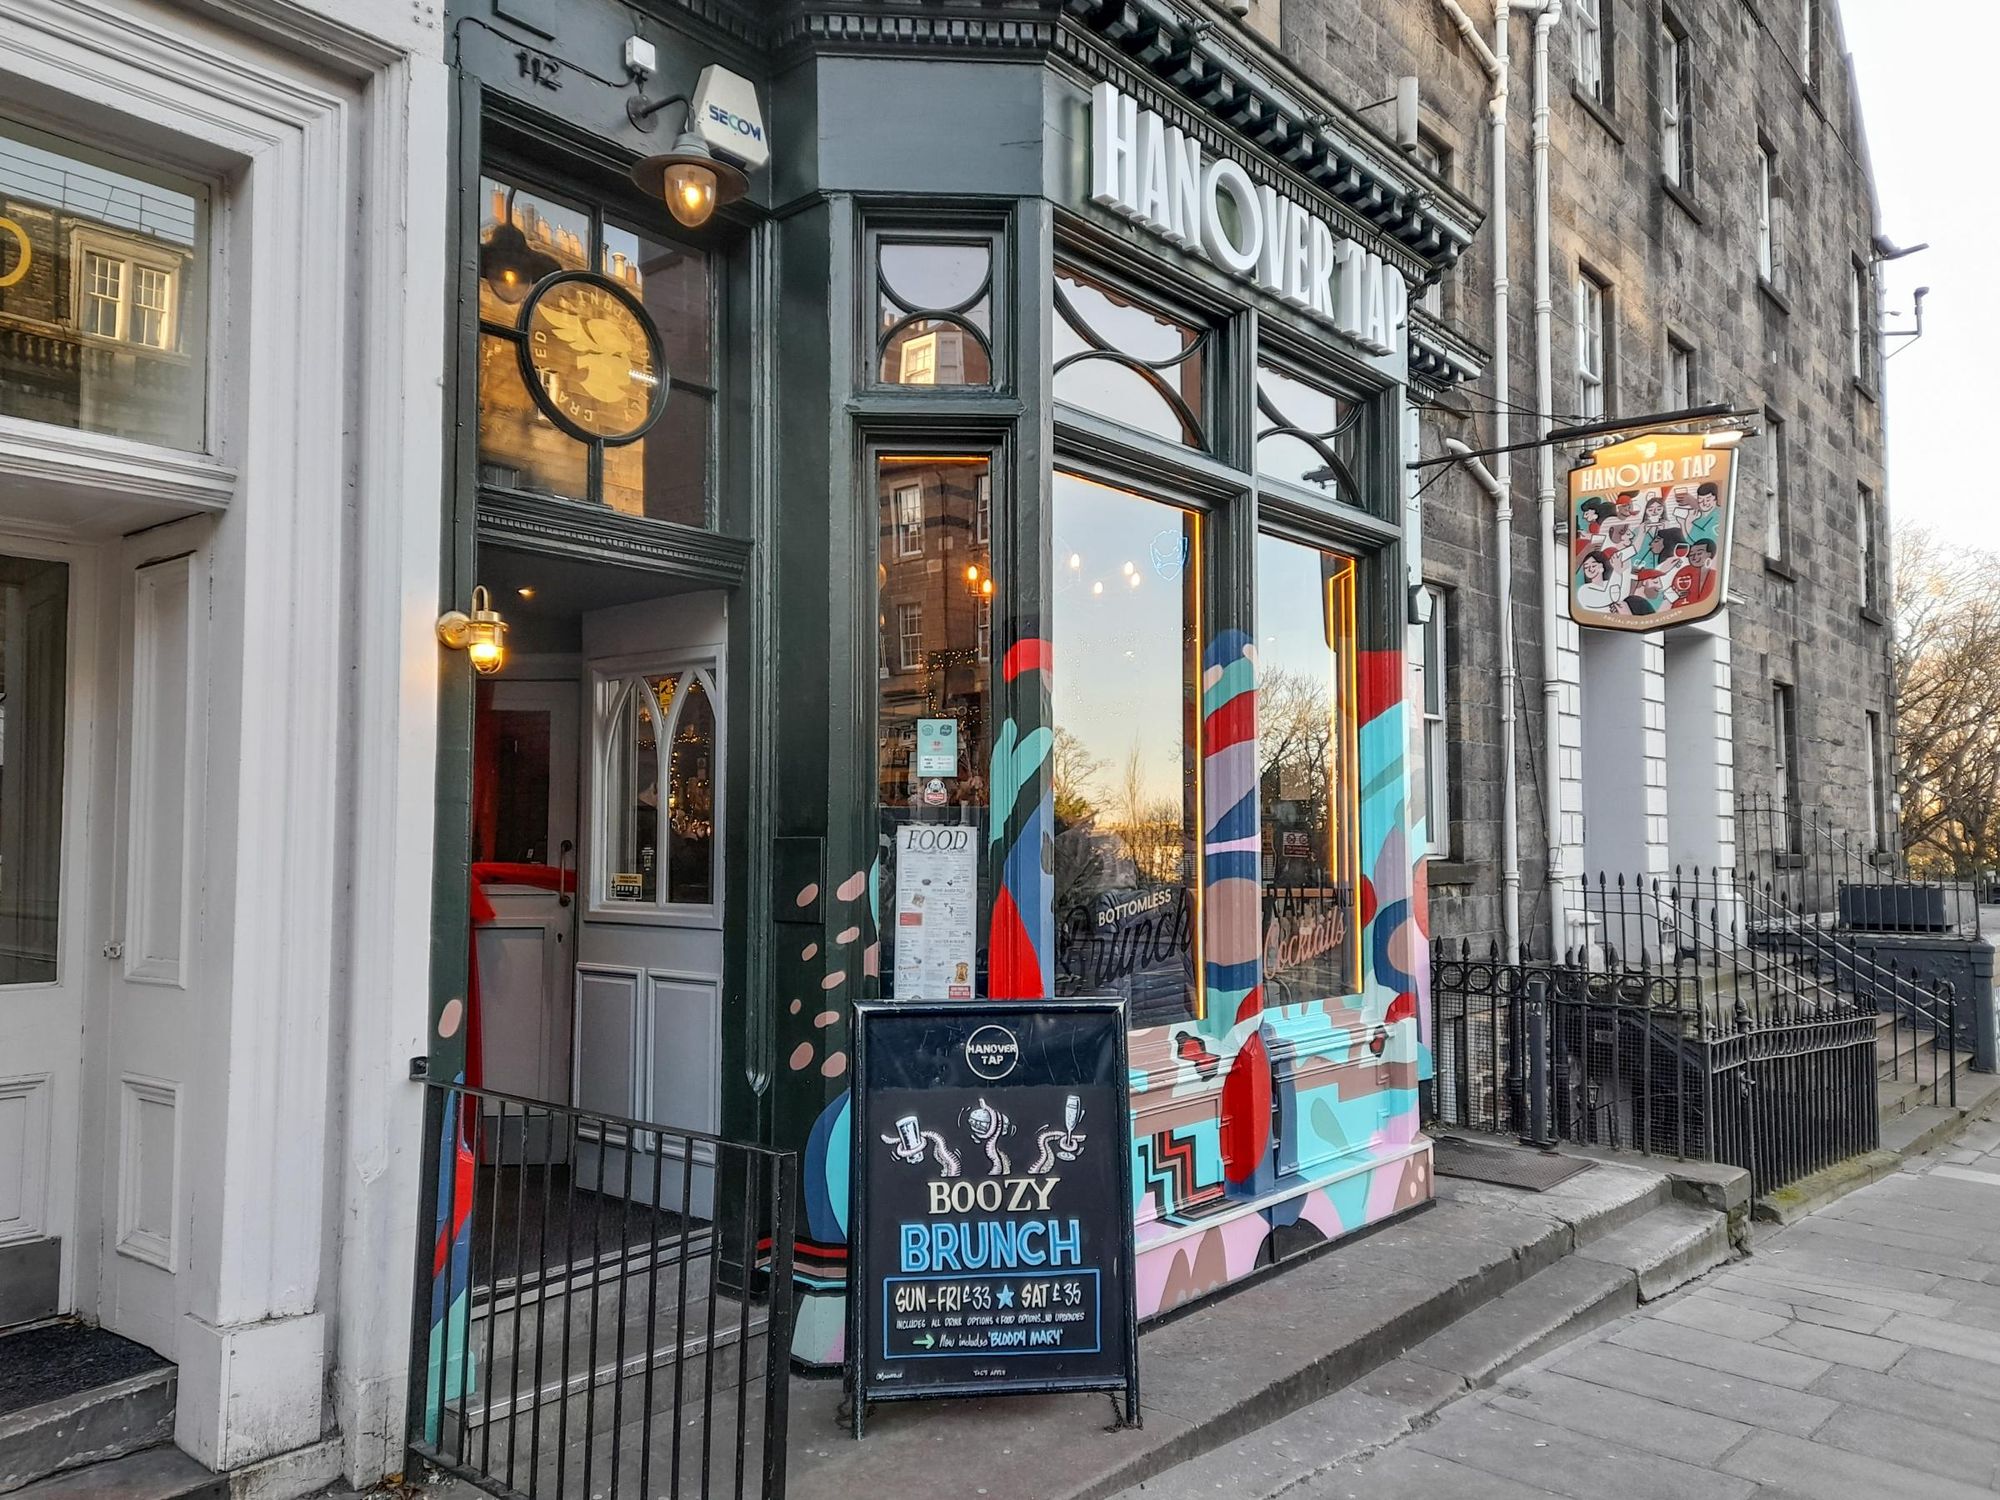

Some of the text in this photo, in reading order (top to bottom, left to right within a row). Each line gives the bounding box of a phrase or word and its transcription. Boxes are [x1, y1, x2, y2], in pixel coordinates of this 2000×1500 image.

[709, 104, 762, 142] SECOM
[1092, 81, 1407, 356] HANOVER TAP
[1581, 453, 1717, 491] HANOVER TAP
[905, 829, 968, 851] FOOD
[1098, 888, 1172, 927] BOTTOMLESS
[1263, 905, 1347, 980] Cocktails
[967, 1043, 1017, 1054] HANOVER
[981, 1055, 1004, 1065] TAP
[928, 1177, 1061, 1215] BOOZY
[900, 1219, 1081, 1273] BRUNCH
[1021, 1283, 1050, 1309] SAT
[931, 1318, 941, 1328] ALL
[967, 1315, 994, 1327] OPTIONS
[1000, 1315, 1016, 1325] FOOD
